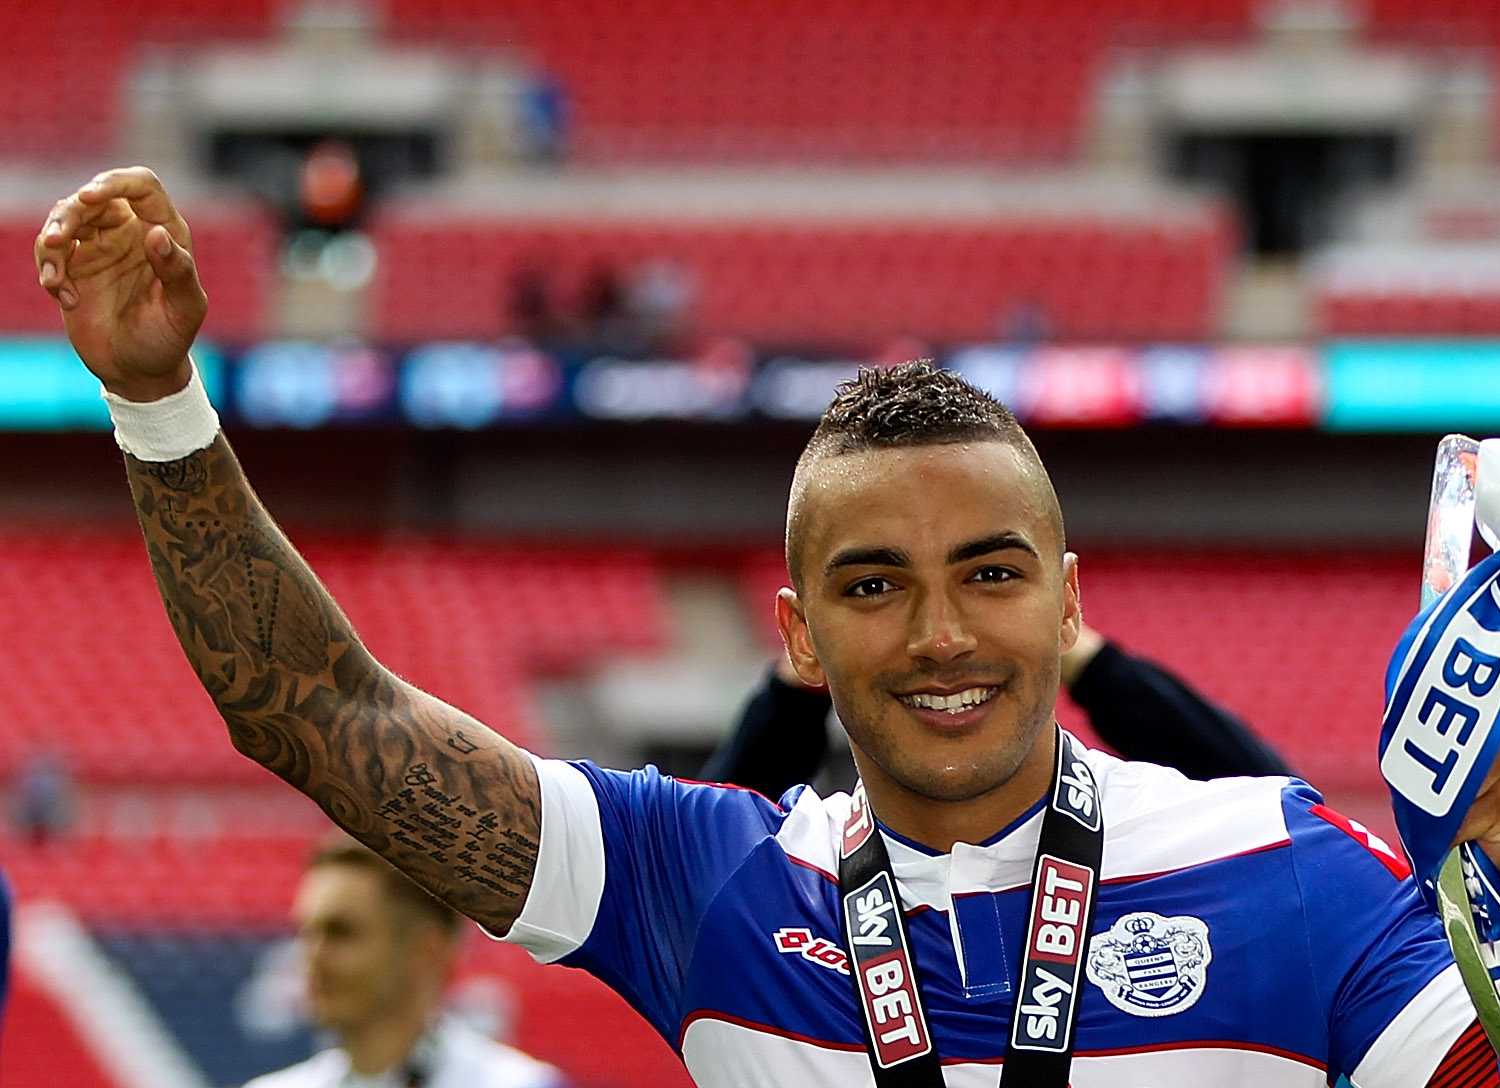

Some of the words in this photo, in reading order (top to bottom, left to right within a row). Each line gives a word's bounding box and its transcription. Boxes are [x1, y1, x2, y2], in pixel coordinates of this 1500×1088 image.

[845, 782, 870, 839] ET
[852, 888, 893, 946] sky
[1035, 866, 1086, 956] BET
[865, 959, 921, 1046] BET
[1021, 967, 1073, 1041] sky
